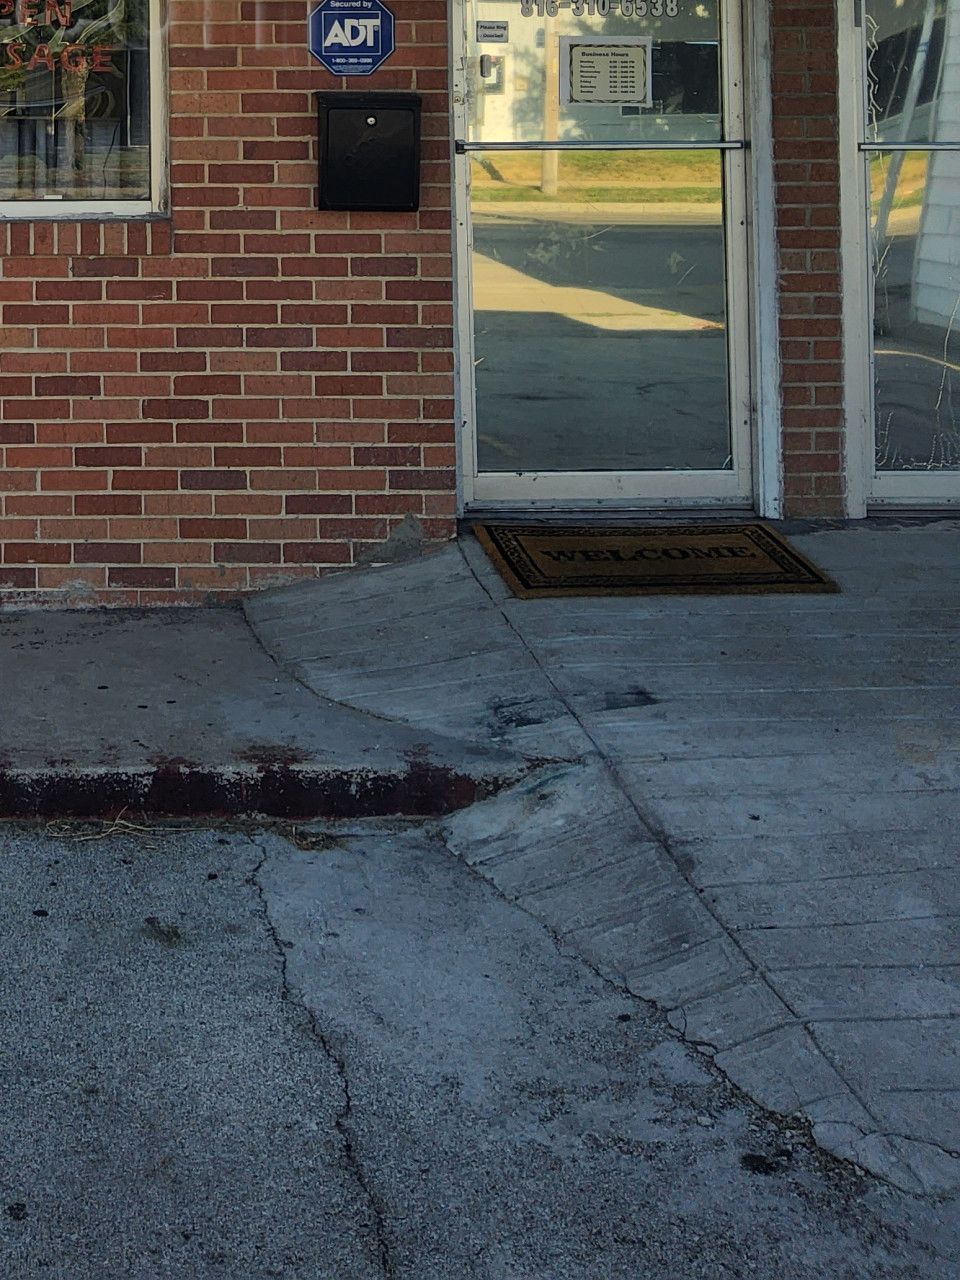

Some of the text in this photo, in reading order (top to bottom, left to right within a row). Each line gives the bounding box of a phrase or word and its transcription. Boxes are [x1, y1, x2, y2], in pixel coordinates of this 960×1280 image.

[330, 0, 373, 9] Secured by
[324, 18, 380, 47] ADT
[542, 545, 756, 563] WELCOME
